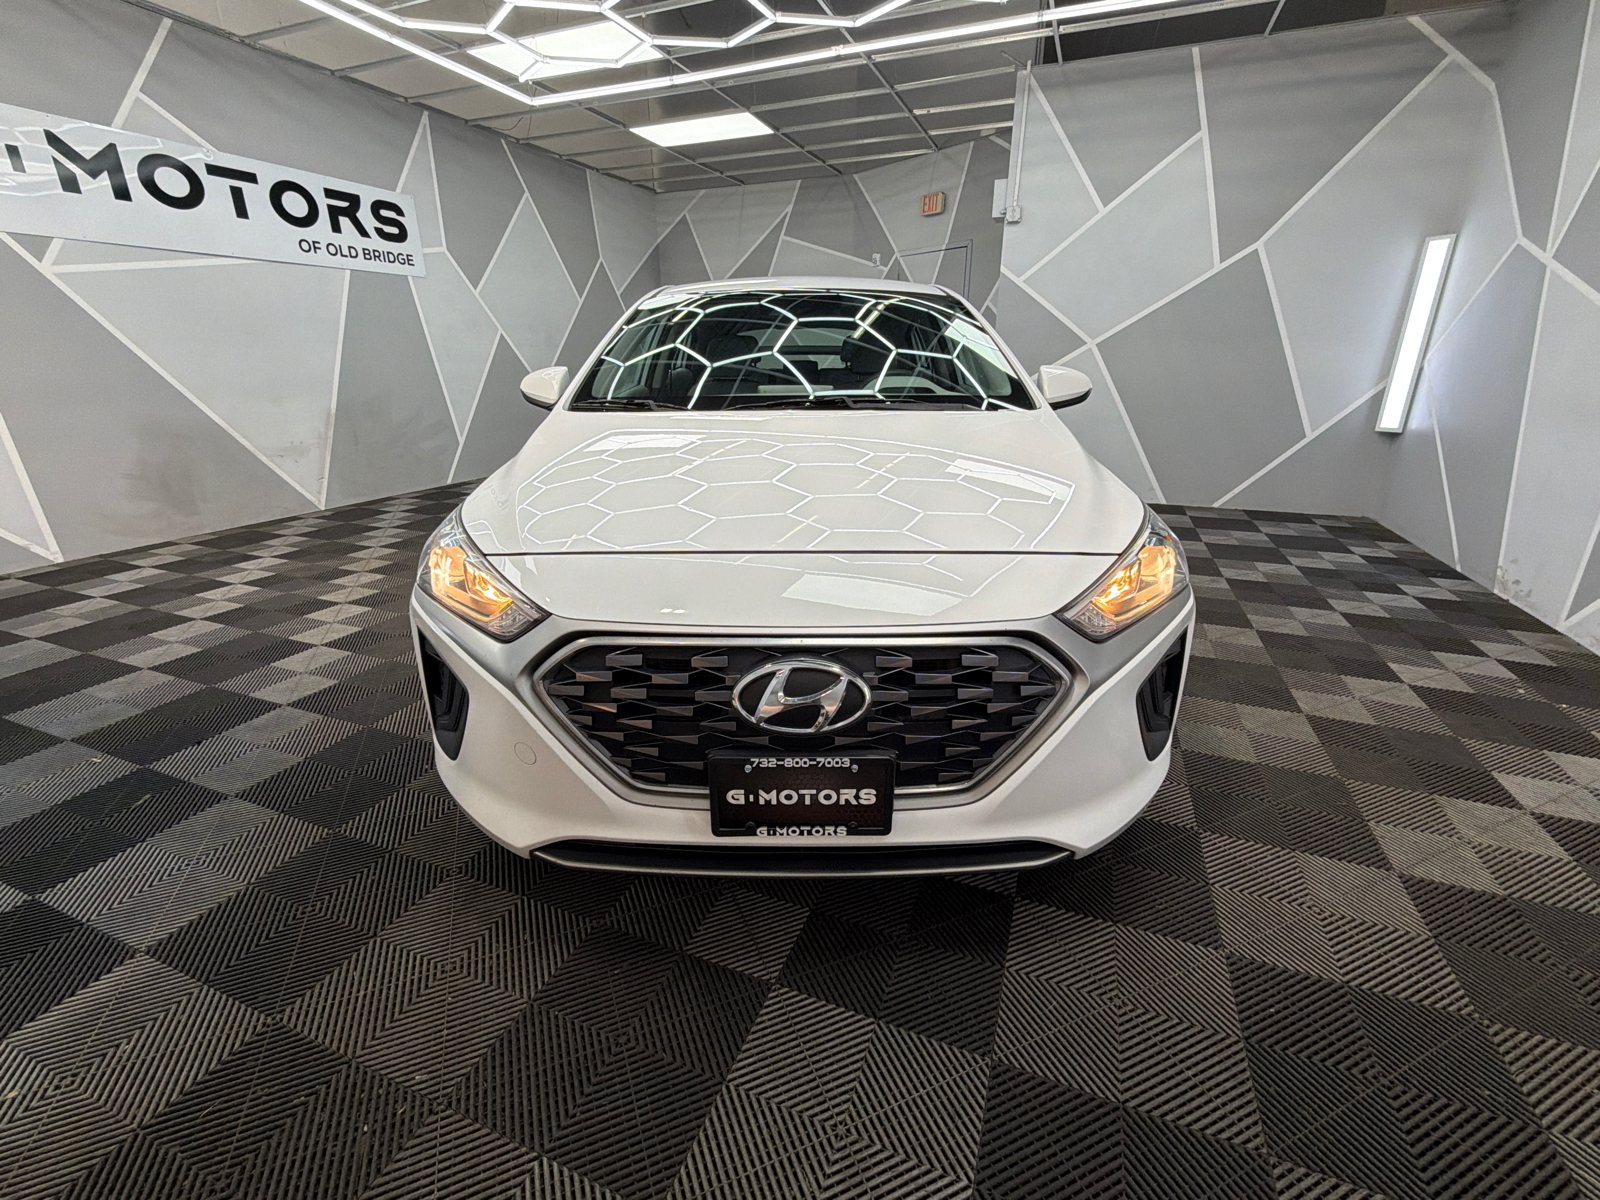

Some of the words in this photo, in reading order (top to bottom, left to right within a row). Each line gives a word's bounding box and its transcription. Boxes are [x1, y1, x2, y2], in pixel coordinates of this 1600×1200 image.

[922, 193, 940, 214] EXIT
[298, 238, 322, 254] OF
[326, 242, 359, 260] OLD
[361, 247, 415, 267] BRIDGE
[750, 758, 851, 768] 732-800-7003
